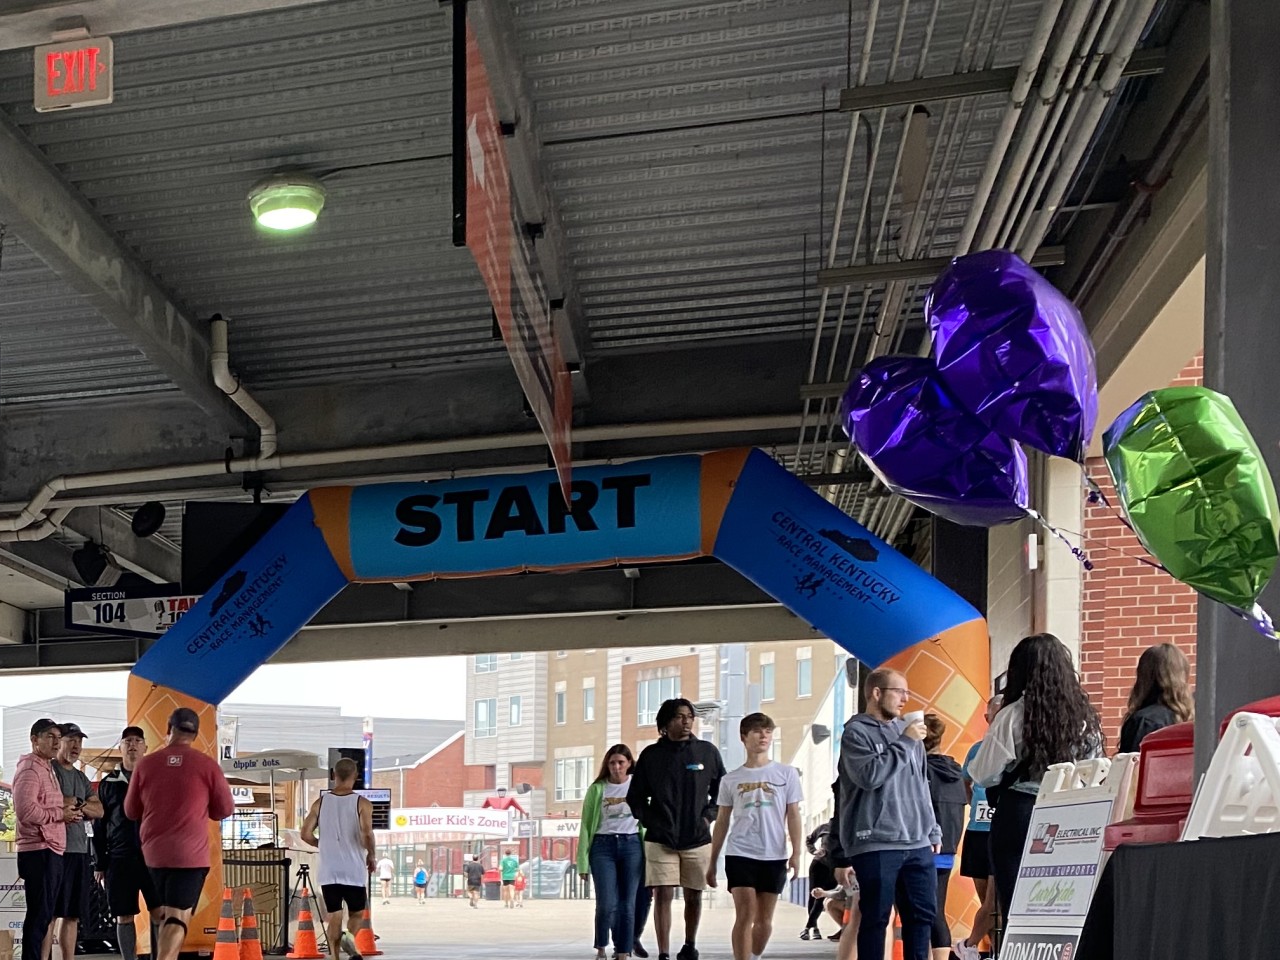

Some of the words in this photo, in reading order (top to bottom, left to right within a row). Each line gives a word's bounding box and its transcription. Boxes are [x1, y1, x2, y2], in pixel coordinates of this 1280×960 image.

[47, 47, 100, 97] EXIT
[394, 473, 651, 547] START
[771, 511, 828, 558] CENTRAL
[828, 552, 901, 605] KENTUCKY
[776, 534, 803, 558] RACE
[802, 555, 872, 605] MANAGEMENT
[91, 591, 126, 601] SECTION
[92, 602, 126, 624] 104
[186, 609, 236, 655] CENTRAL
[233, 553, 288, 610] KENTUCKY
[209, 628, 233, 652] RACE
[231, 575, 285, 631] MANAGEMENT
[409, 814, 444, 827] Hiller
[446, 813, 475, 827] Kid's
[477, 815, 507, 828] Zone
[1055, 827, 1089, 839] ELECTRICAL
[1021, 866, 1056, 877] PROUDLY
[1056, 865, 1096, 876] SUPPORTS
